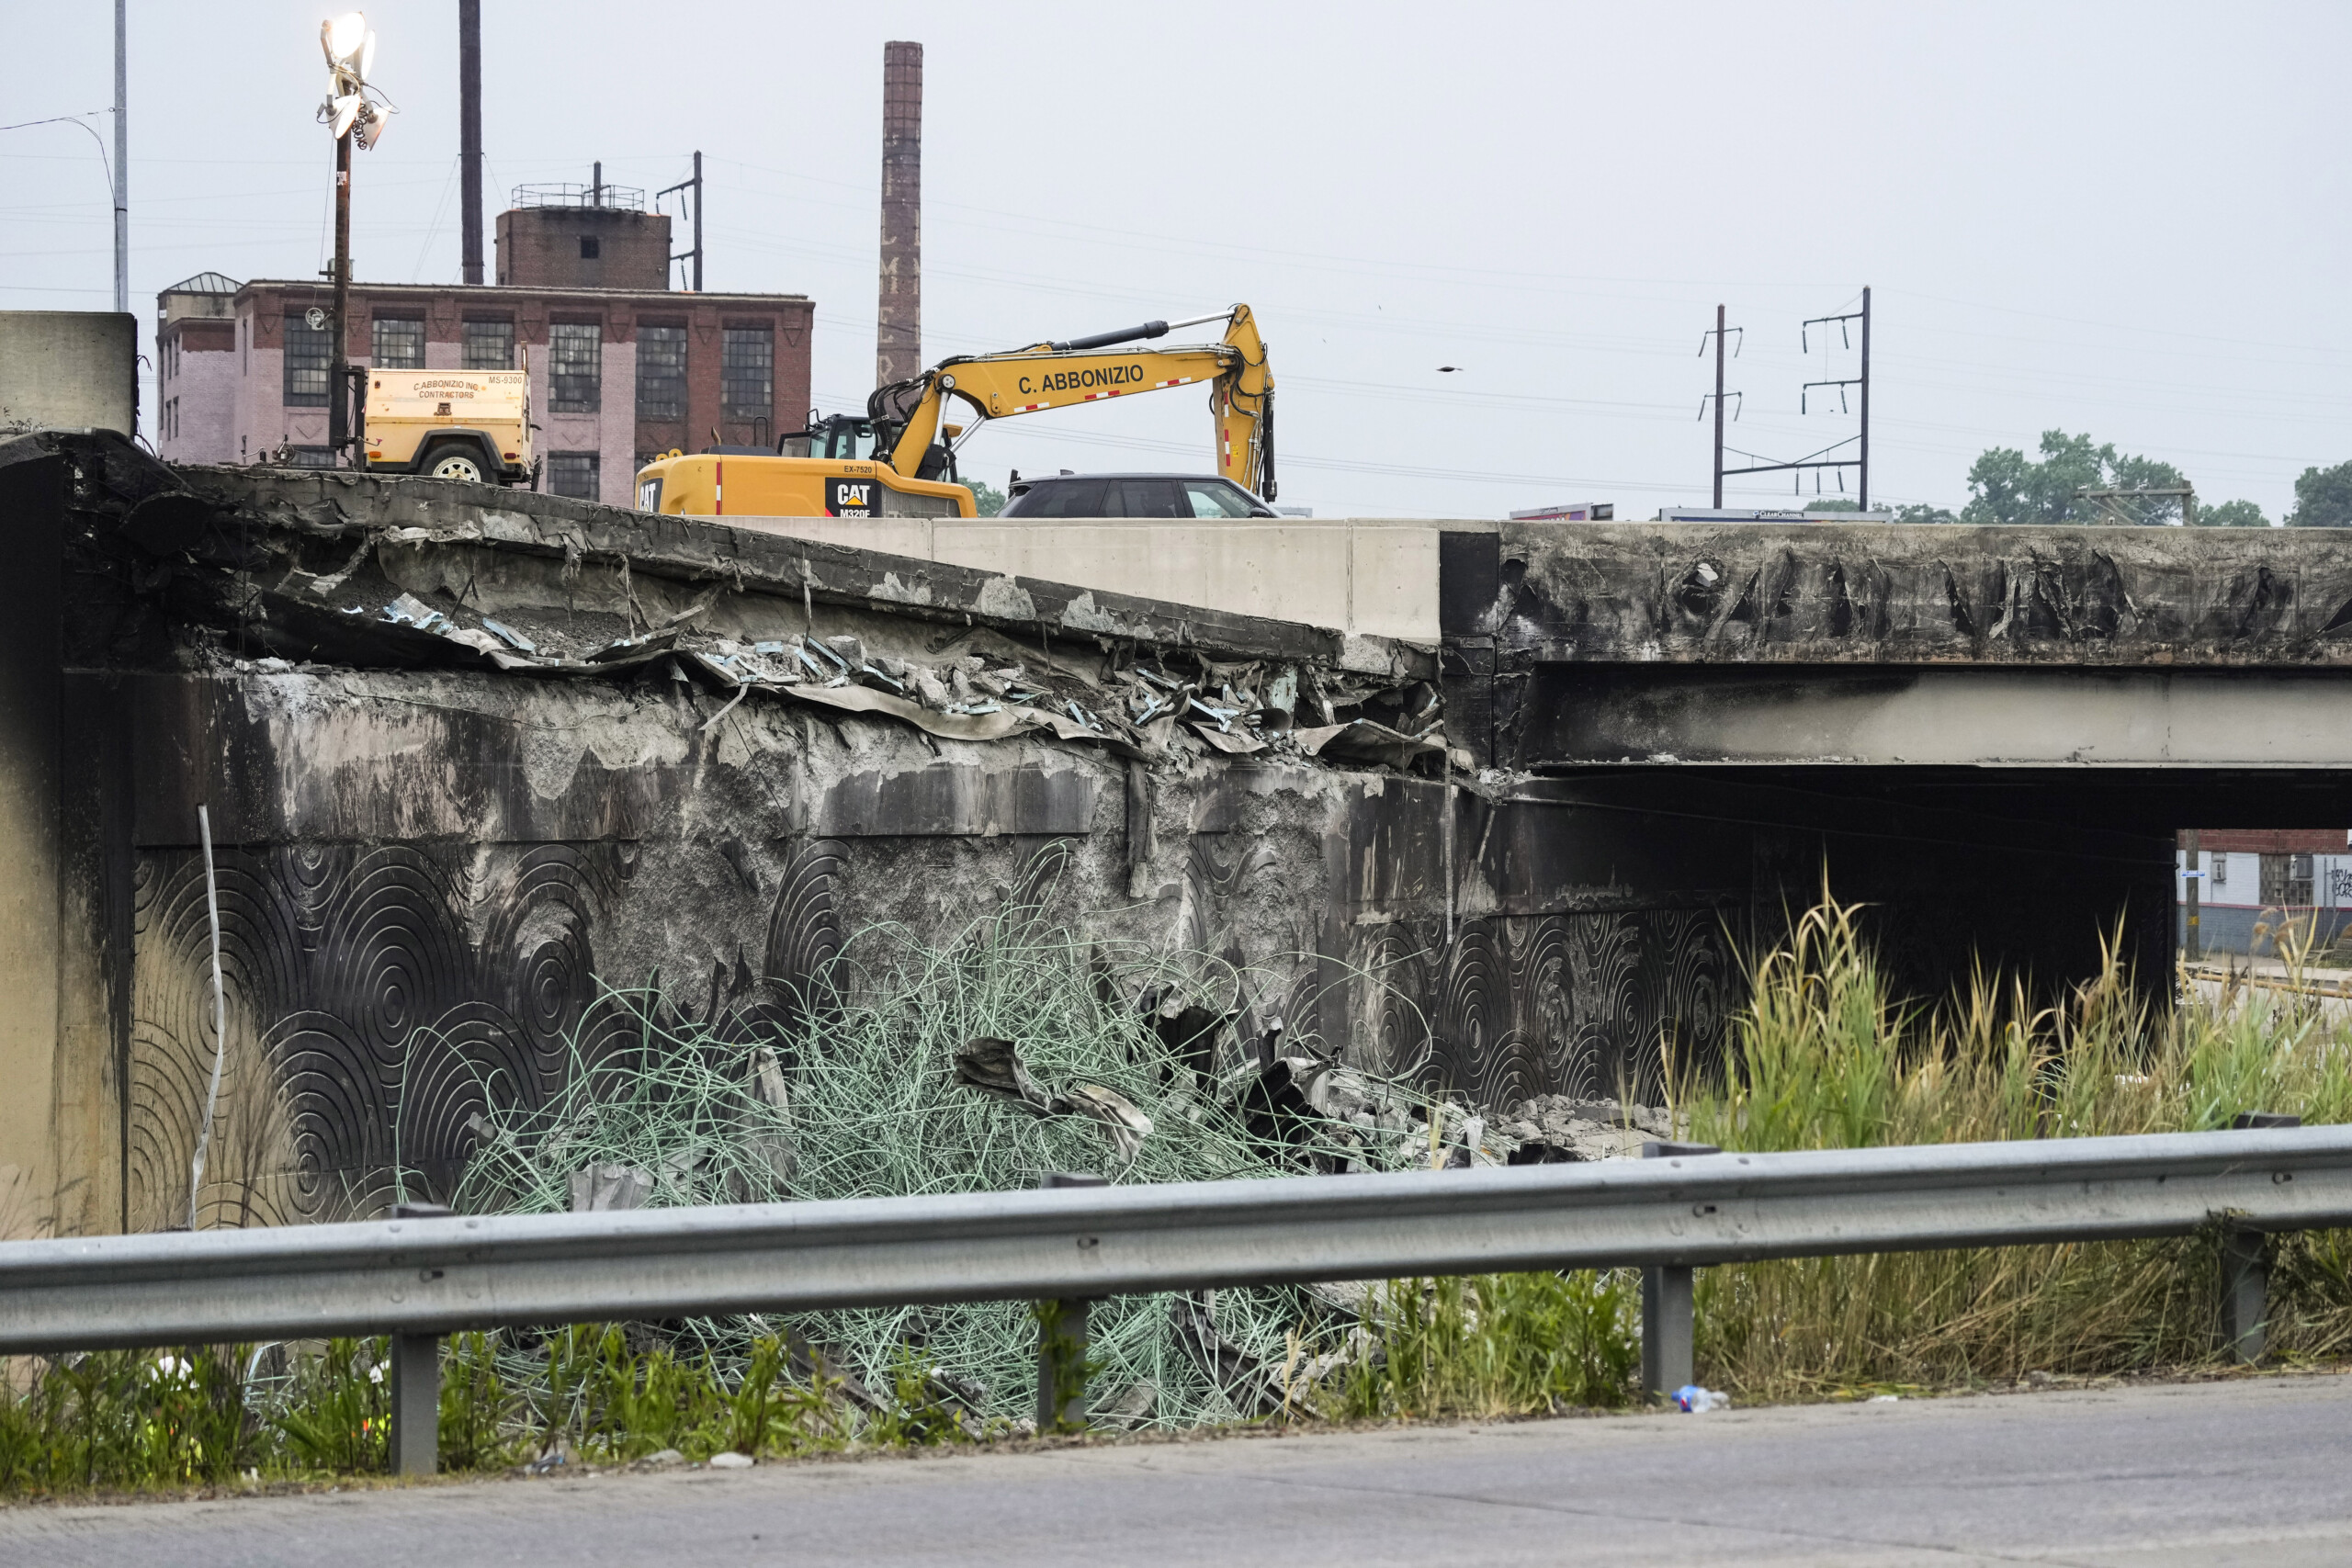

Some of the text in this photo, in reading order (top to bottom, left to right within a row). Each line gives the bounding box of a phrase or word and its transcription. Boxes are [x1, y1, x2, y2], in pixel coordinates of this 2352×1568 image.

[488, 376, 523, 384] MS-9300
[1019, 365, 1144, 394] C. ABBONIZIO
[419, 390, 475, 399] CONTRACTORS
[843, 465, 872, 473] EX-7520
[639, 482, 656, 513] CAT
[837, 484, 871, 505] CAT
